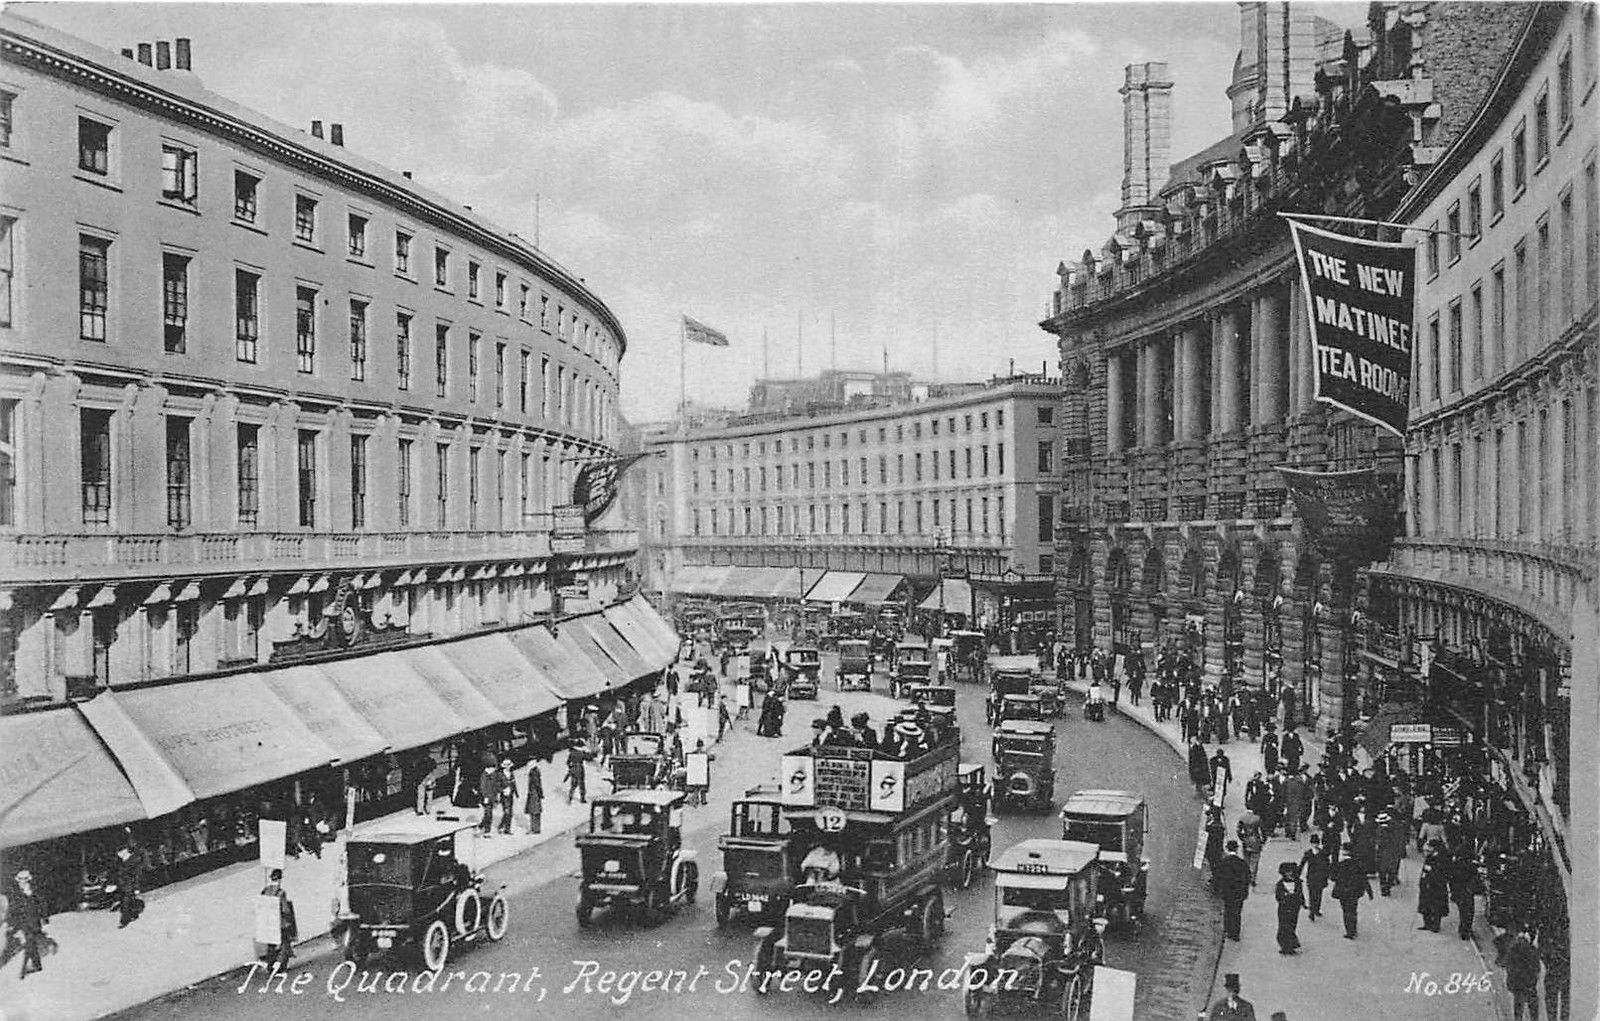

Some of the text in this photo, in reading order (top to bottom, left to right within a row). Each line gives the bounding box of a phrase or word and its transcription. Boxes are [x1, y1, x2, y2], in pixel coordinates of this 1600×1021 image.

[1308, 249, 1403, 297] THE NEW
[1316, 295, 1409, 353] MATINEE
[1318, 344, 1407, 406] TEA ROOMS
[822, 816, 841, 830] 12
